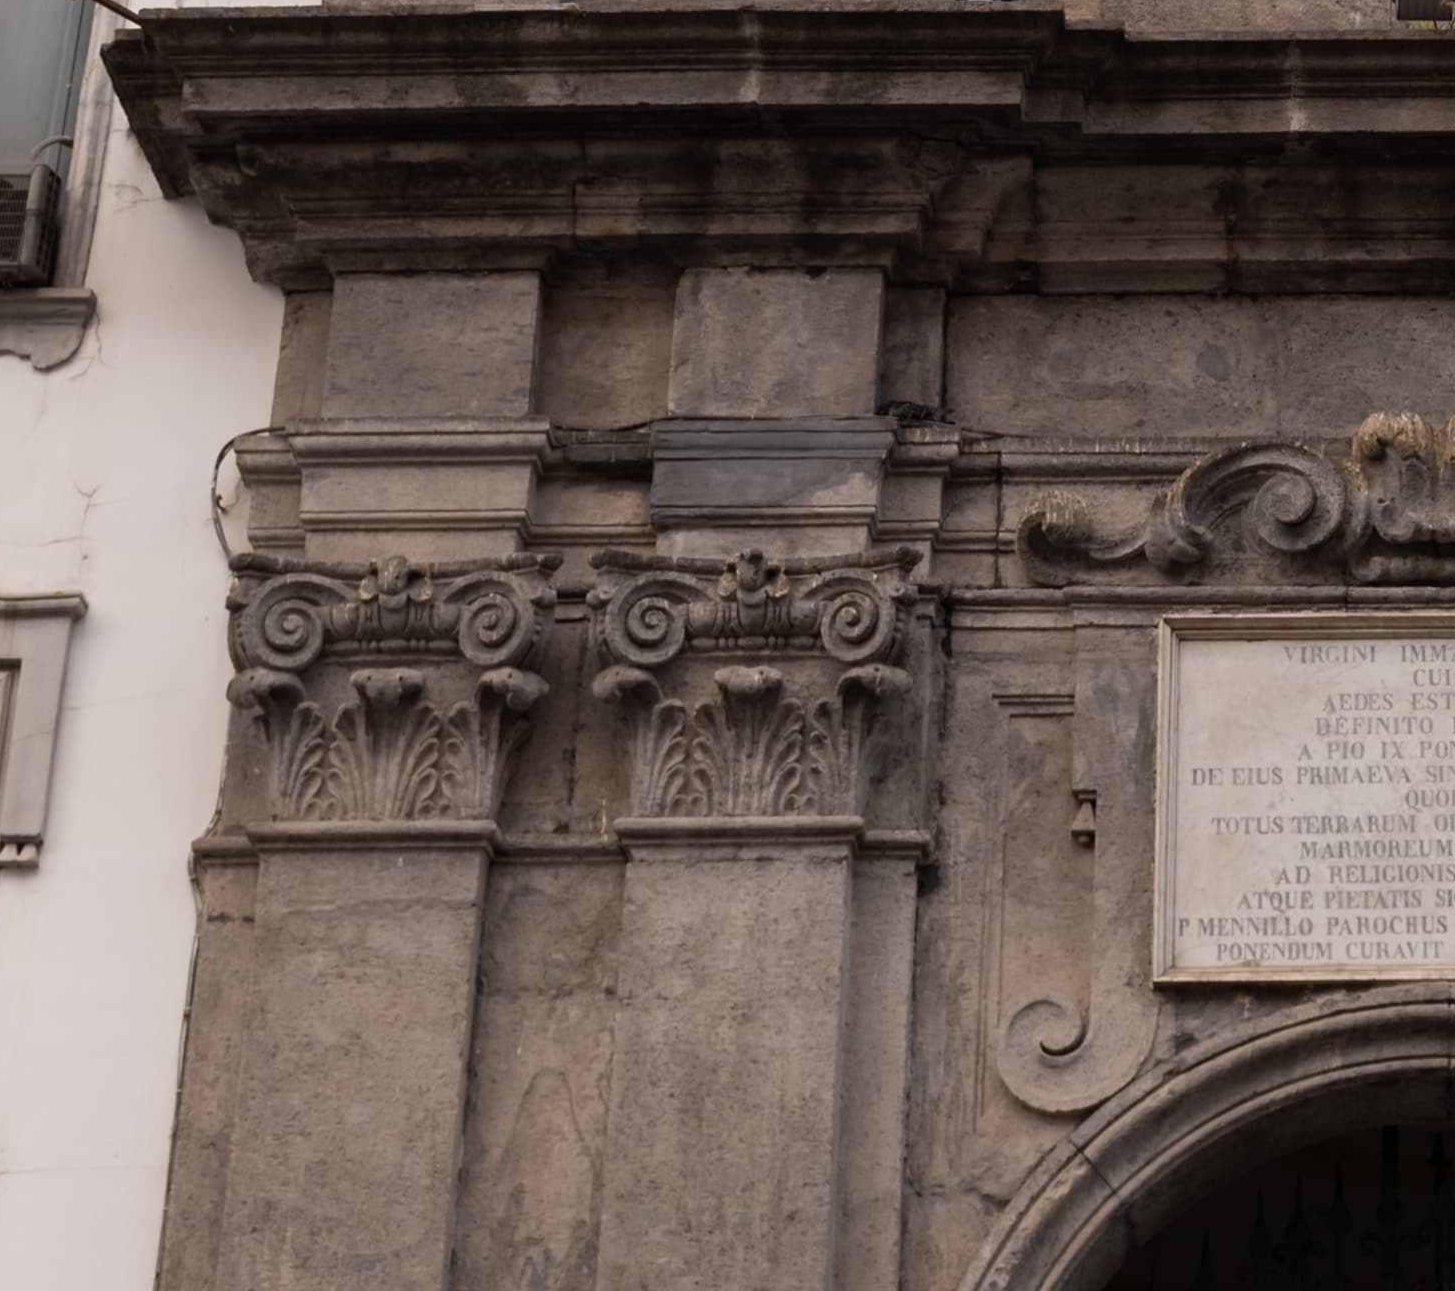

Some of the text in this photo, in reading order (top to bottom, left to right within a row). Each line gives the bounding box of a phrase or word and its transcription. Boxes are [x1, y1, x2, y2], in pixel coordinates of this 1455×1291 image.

[1284, 645, 1377, 664] VIRGINI
[1413, 669, 1452, 687] CUI
[1323, 693, 1394, 713] AEDES
[1411, 692, 1455, 710] EST
[1315, 716, 1434, 736] DEFINITO
[1298, 743, 1313, 761] A
[1327, 741, 1365, 760] PIO
[1381, 741, 1405, 759] IX
[1192, 768, 1224, 786] DE
[1232, 767, 1283, 786] EIUS
[1296, 765, 1411, 785] PRIMAEVA
[1211, 816, 1284, 835] TOTUS
[1292, 814, 1416, 834] TERRARUM
[1299, 839, 1453, 859] MARMOREUM
[1276, 866, 1311, 885] AD
[1237, 891, 1314, 914] ATQUE
[1324, 890, 1422, 909] PIETATIS
[1197, 917, 1313, 937] MENNILLO
[1326, 915, 1448, 935] PAROCHUS
[1216, 942, 1333, 961] PONENDUM
[1345, 941, 1445, 960] CURAVIT
